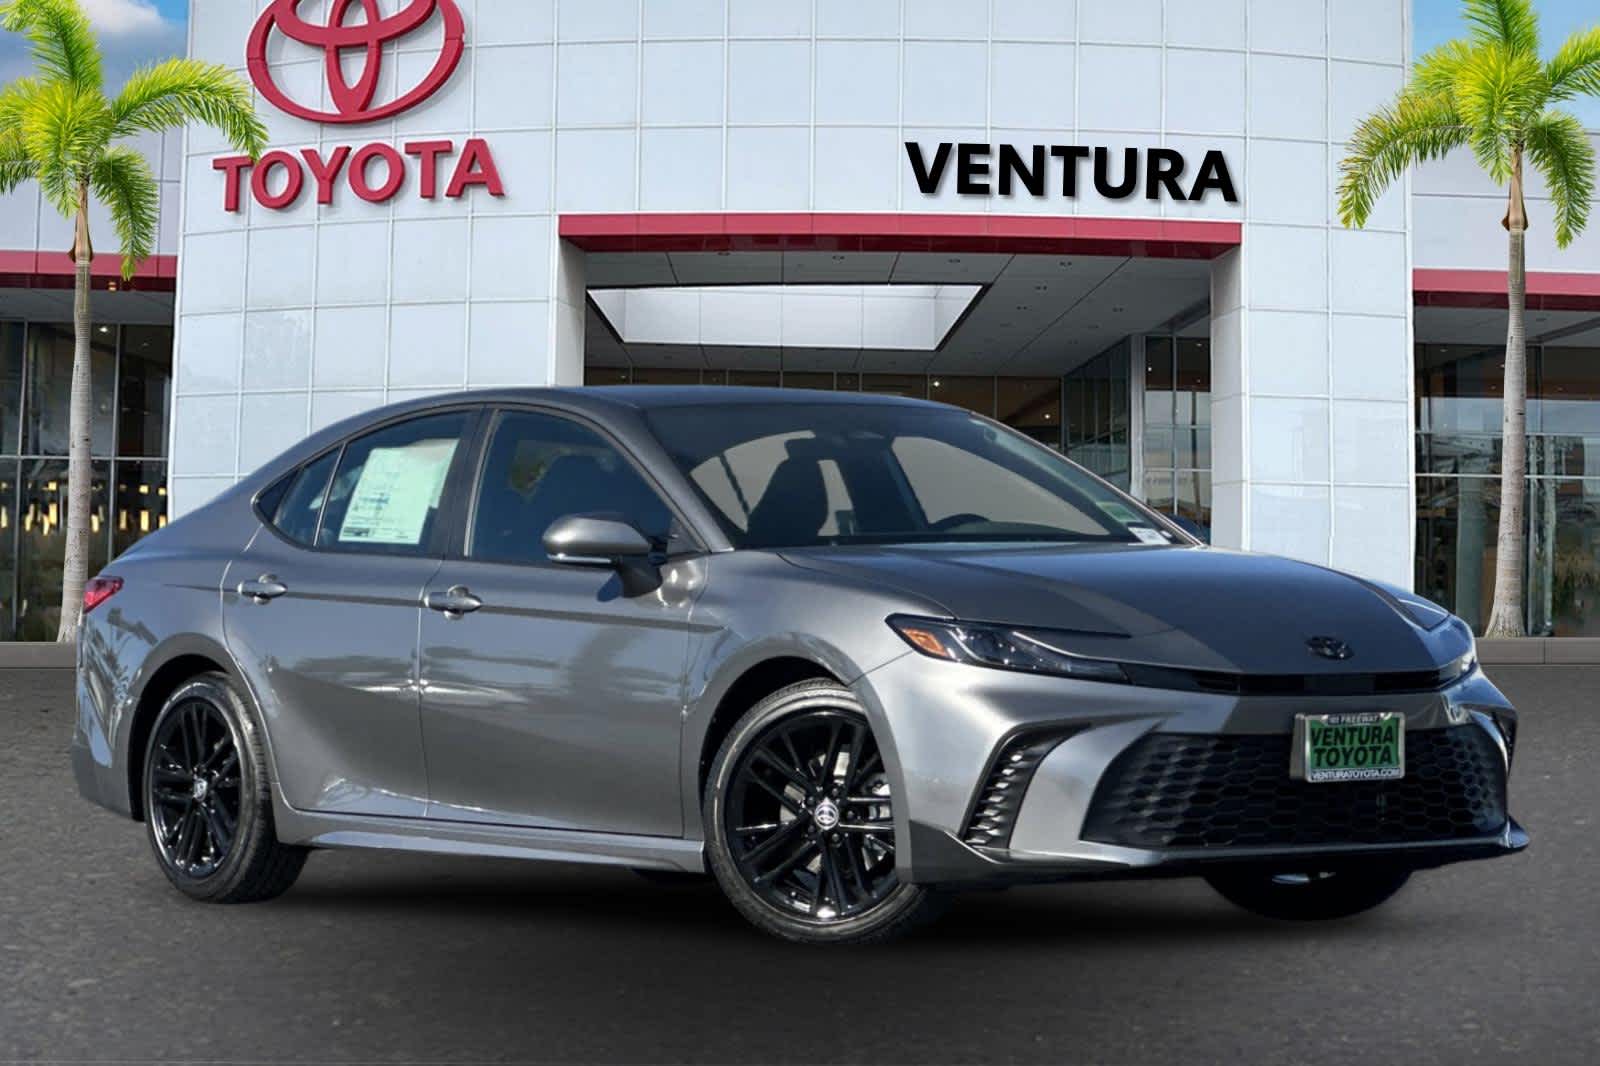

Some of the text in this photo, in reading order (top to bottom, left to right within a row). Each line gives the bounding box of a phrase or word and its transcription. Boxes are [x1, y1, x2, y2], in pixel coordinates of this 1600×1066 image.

[213, 138, 505, 212] TOYOTA
[905, 142, 1237, 202] VENTURA
[1311, 726, 1393, 746] VENTURA
[1314, 746, 1393, 766] TOYOTA
